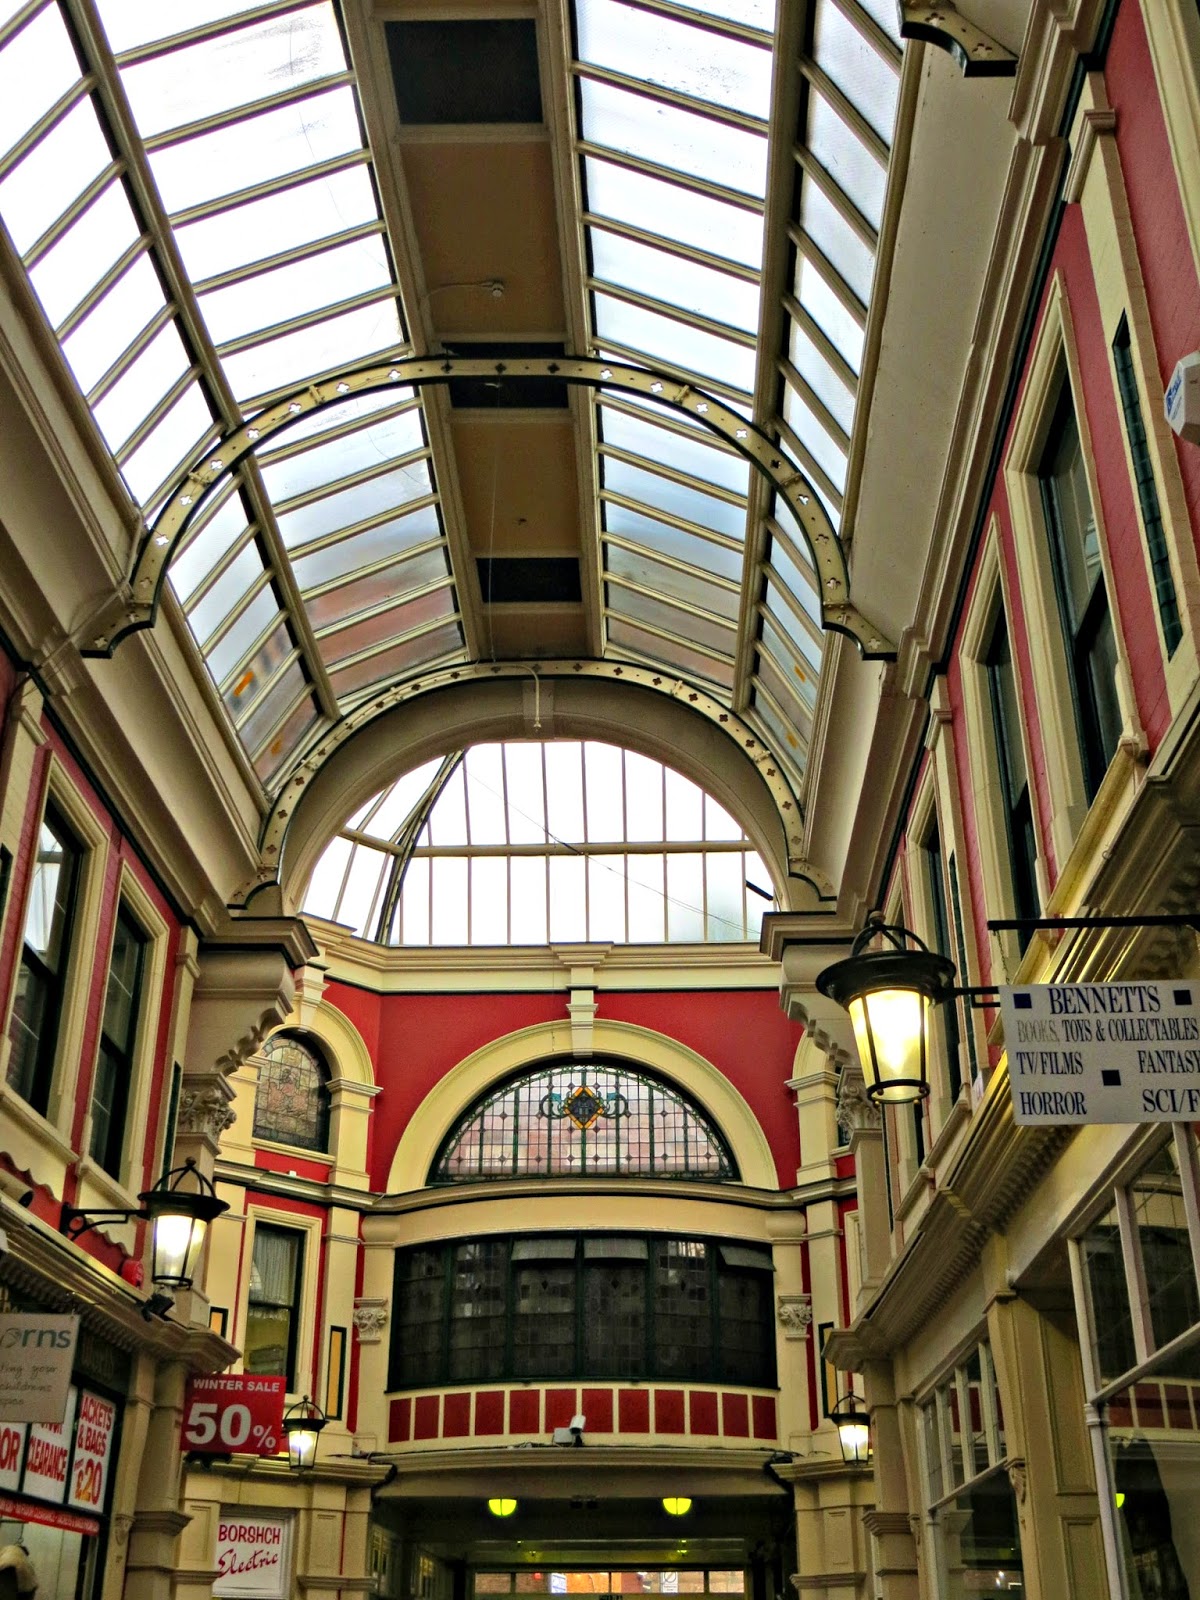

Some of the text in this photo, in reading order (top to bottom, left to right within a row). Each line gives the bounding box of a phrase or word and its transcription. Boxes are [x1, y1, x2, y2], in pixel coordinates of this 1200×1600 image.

[1049, 985, 1161, 1014] BENNETTS
[1062, 1018, 1093, 1042] TOYS
[1096, 1019, 1105, 1042] &
[1108, 1017, 1199, 1042] COLLECTABLES
[1016, 1050, 1200, 1075] TV/FILMS FANTASY
[1020, 1089, 1200, 1115] HORROR SCI/F
[193, 1379, 280, 1392] WINTER SALE
[81, 1396, 113, 1431] ACKETS
[185, 1403, 276, 1448] 50%
[78, 1424, 85, 1448] &
[85, 1427, 107, 1457] BAGS
[27, 1436, 68, 1482] CLEARANCE
[75, 1458, 103, 1505] £20
[218, 1524, 281, 1544] BORSHCH
[217, 1548, 278, 1578] Electric
